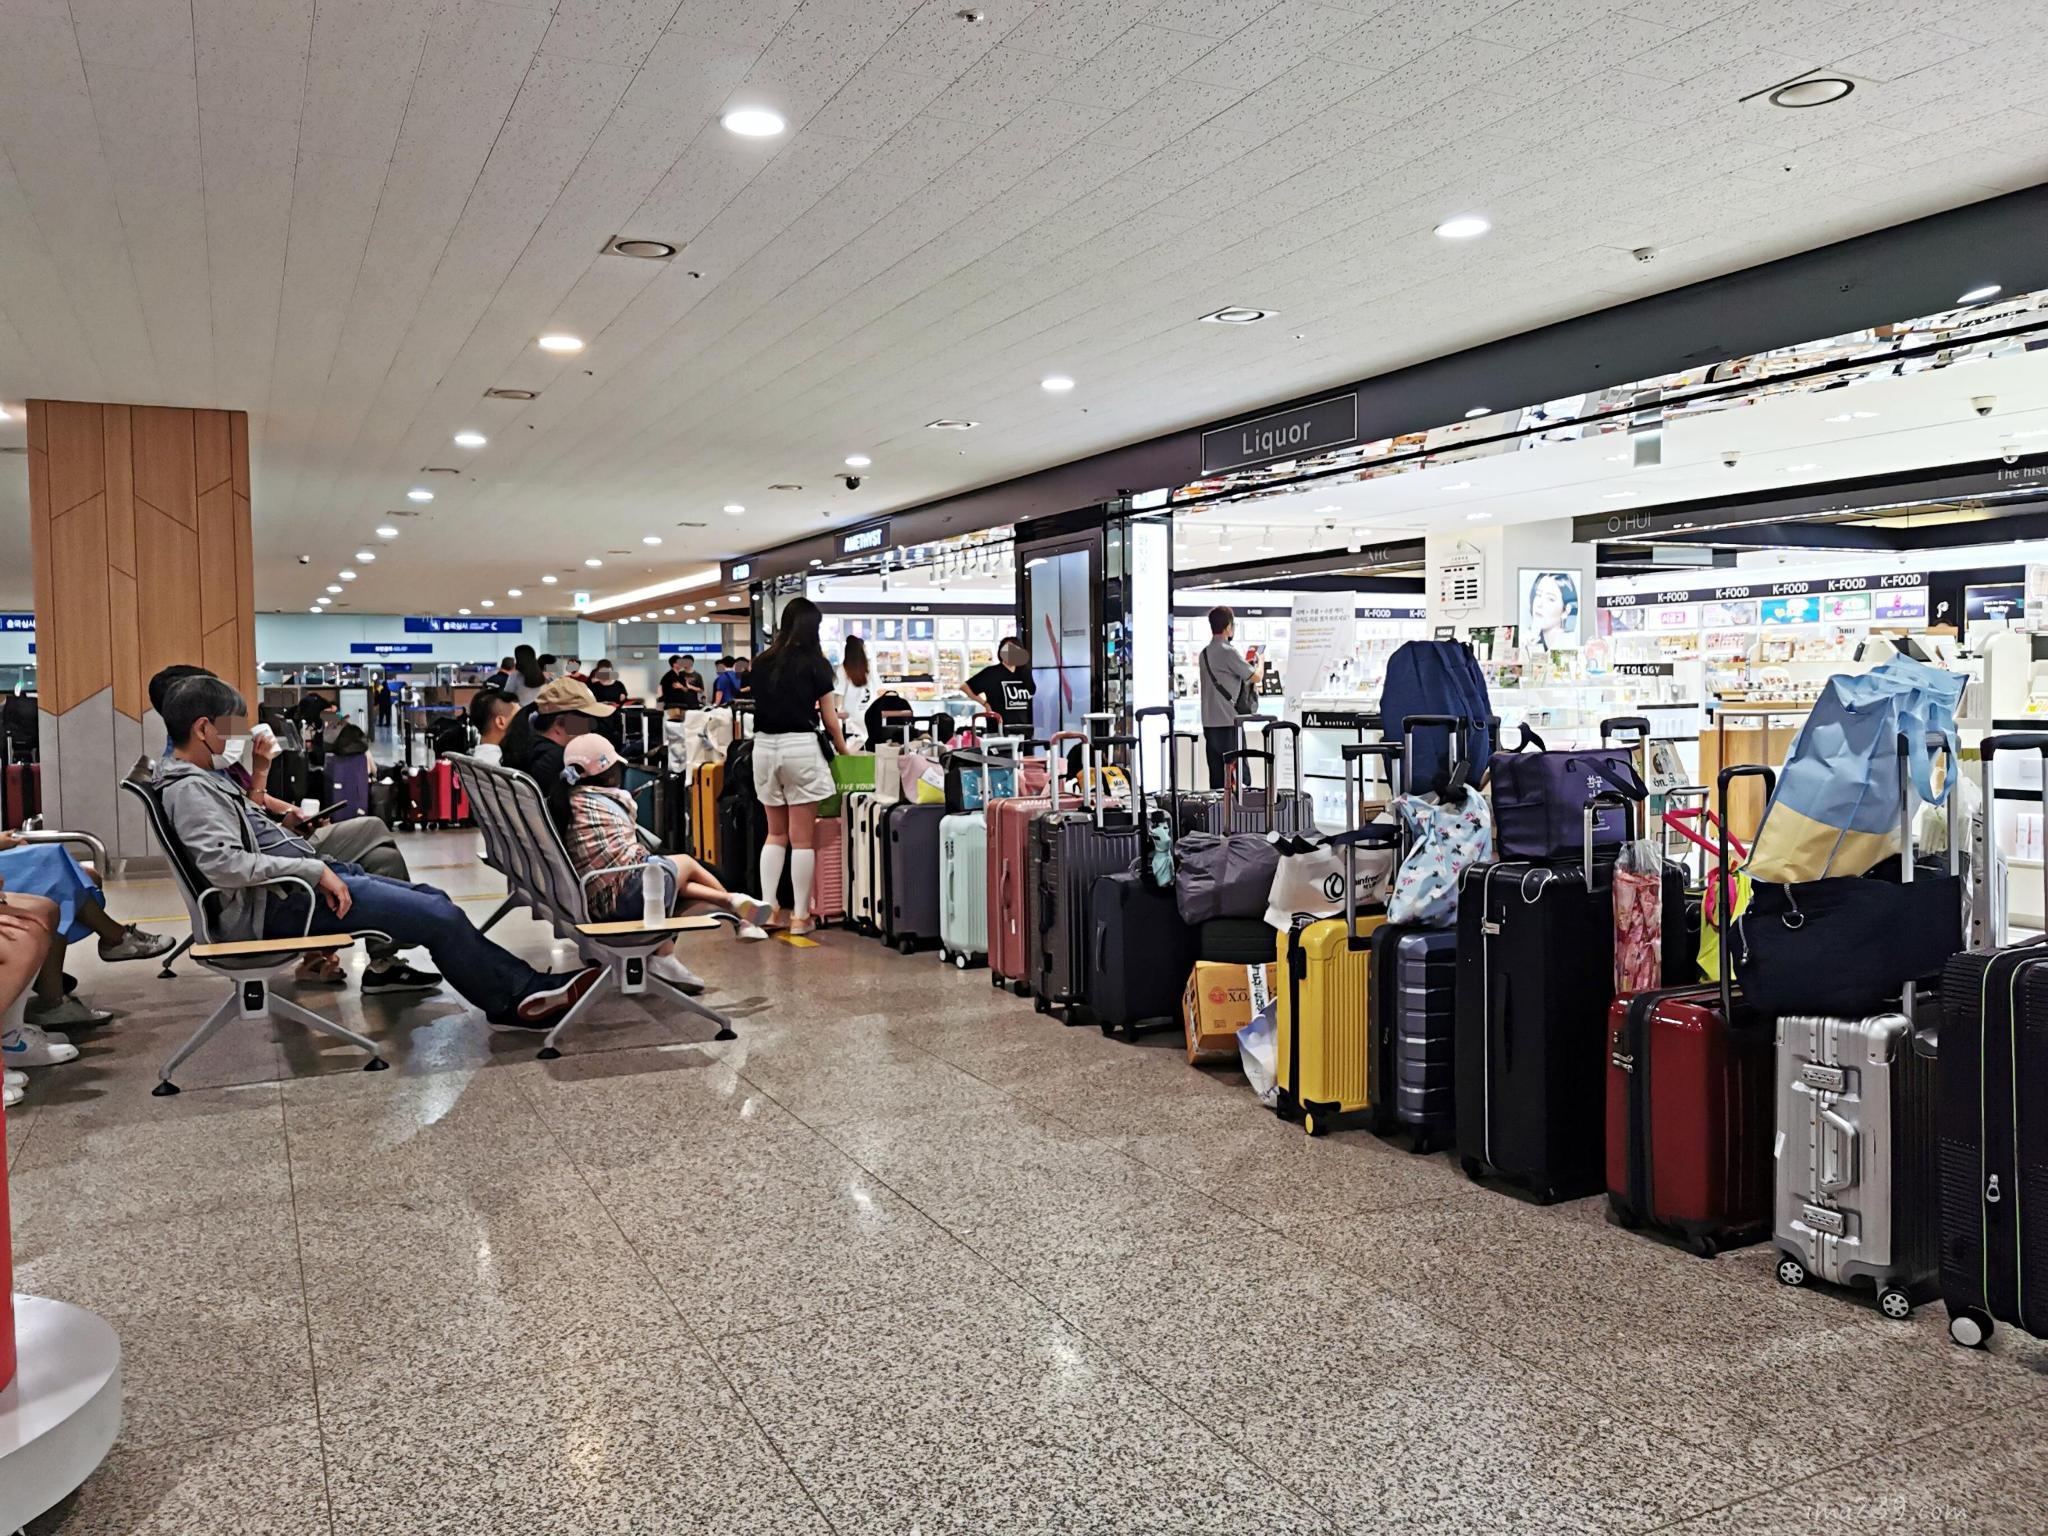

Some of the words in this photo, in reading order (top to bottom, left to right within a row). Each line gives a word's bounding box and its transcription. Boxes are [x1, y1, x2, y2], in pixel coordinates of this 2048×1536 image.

[1243, 421, 1312, 455] Liquor
[2023, 465, 2048, 478] hist
[1607, 516, 1621, 533] O
[1625, 511, 1651, 531] HUI
[1828, 578, 1867, 591] K-FOOD
[1880, 574, 1921, 587] K-FOOD
[1715, 586, 1750, 599] K-FOOD
[1772, 582, 1809, 595] K-FOOD
[1606, 594, 1636, 606] K-FOOD
[1657, 590, 1689, 602] K-FOOD
[1364, 608, 1391, 617] K-FOOD
[1409, 609, 1426, 617] K-FO
[836, 782, 853, 791] LIVE
[855, 782, 875, 790] YOUN
